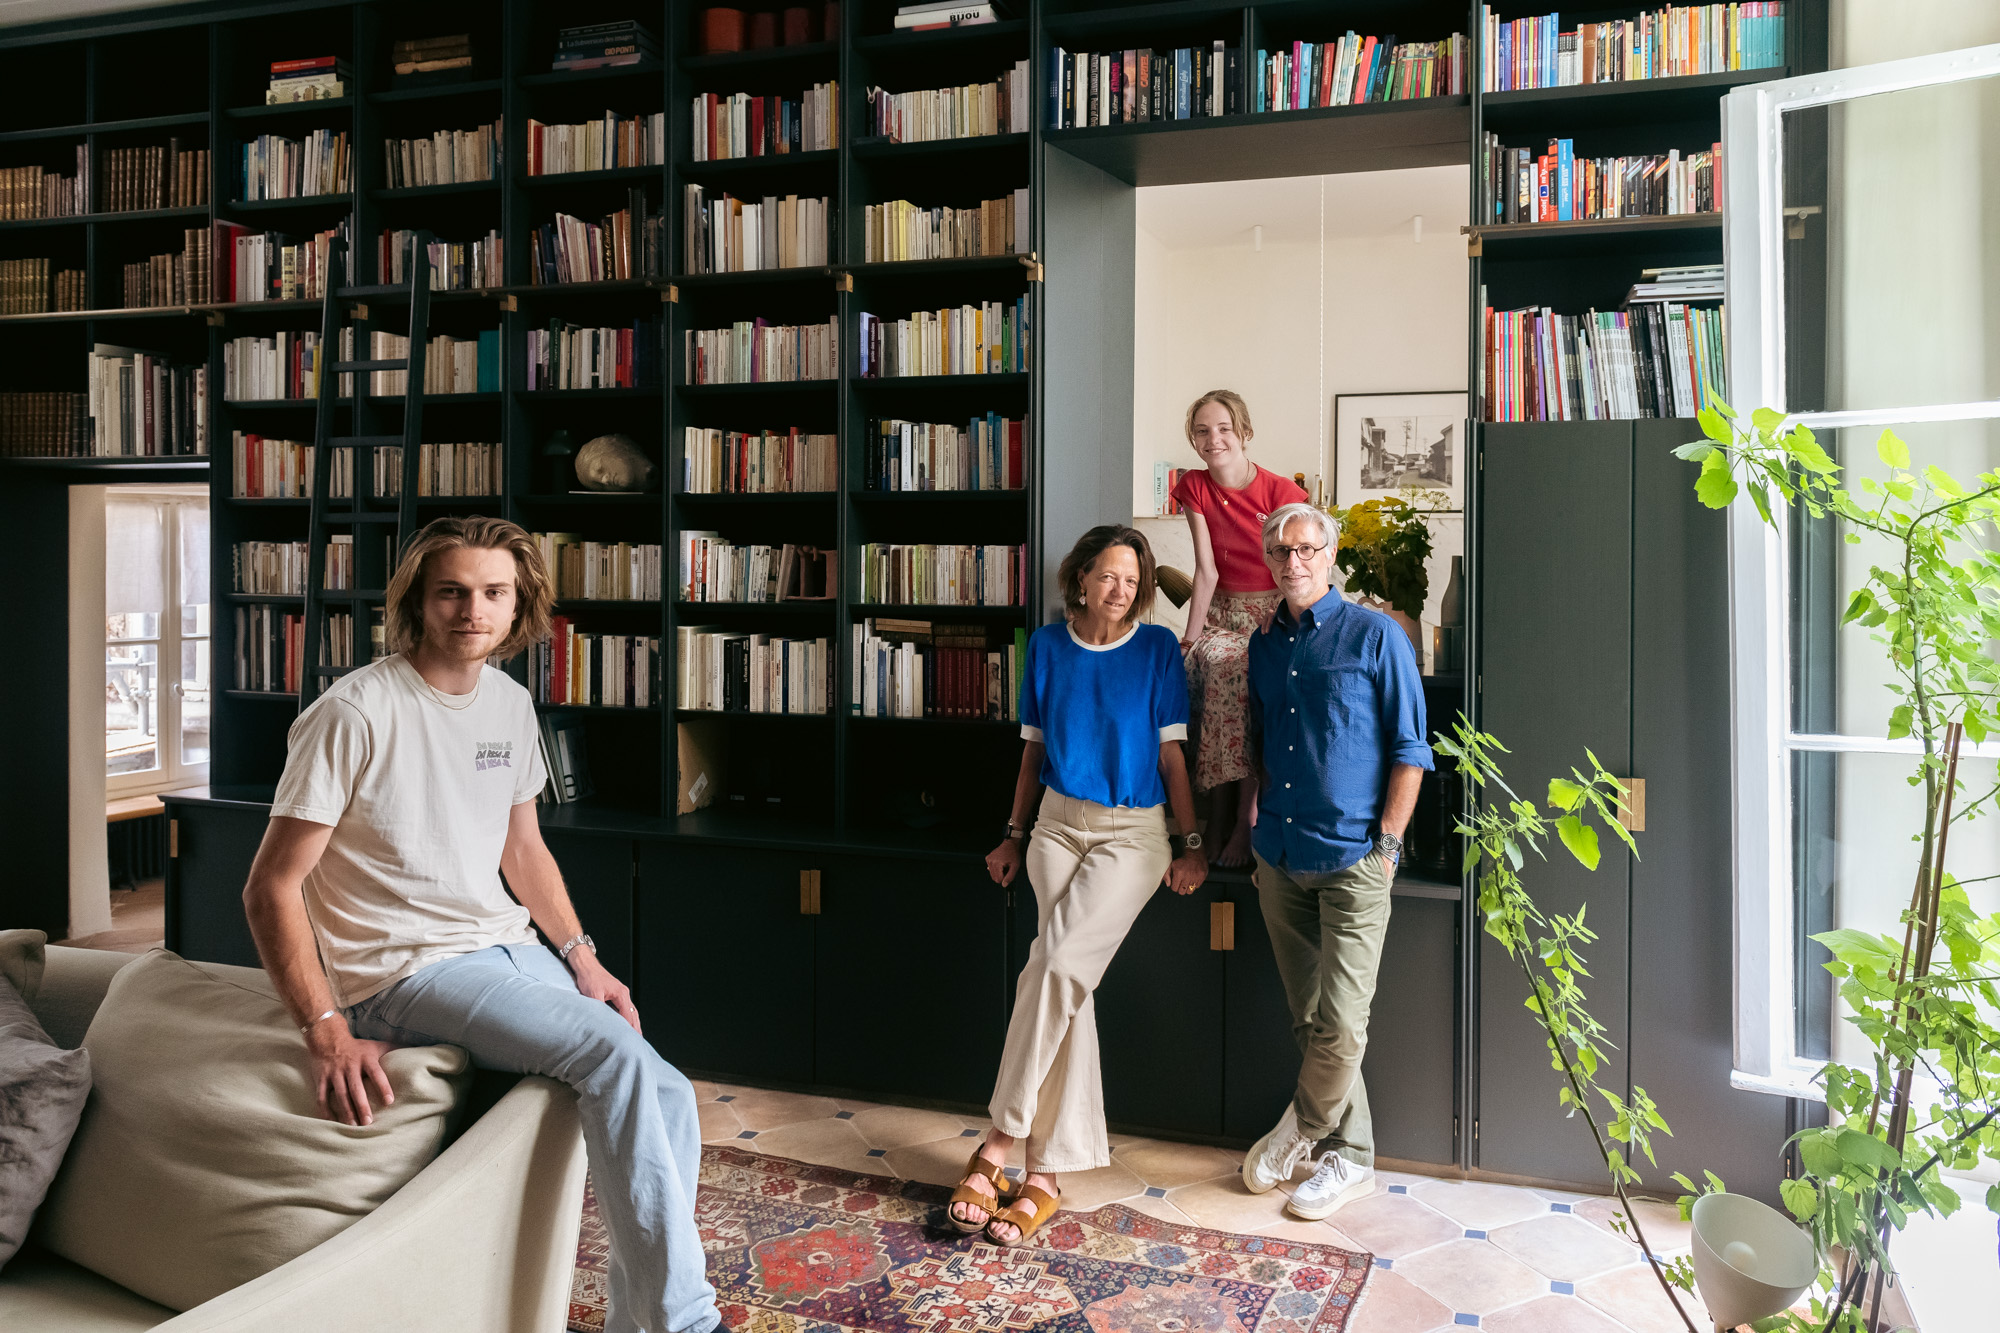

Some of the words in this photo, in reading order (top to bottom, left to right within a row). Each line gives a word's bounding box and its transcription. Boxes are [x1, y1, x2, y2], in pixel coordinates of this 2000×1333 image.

[950, 12, 980, 22] BIJOU
[604, 47, 615, 56] GIO
[616, 45, 635, 54] PONTI
[1140, 54, 1148, 88] CARTEL
[1519, 172, 1529, 208] VANGO
[476, 742, 487, 750] DA
[487, 742, 503, 750] ROSA
[475, 751, 486, 760] DA
[486, 750, 502, 758] ROSA
[475, 761, 486, 771] DA
[486, 759, 502, 769] ROSA
